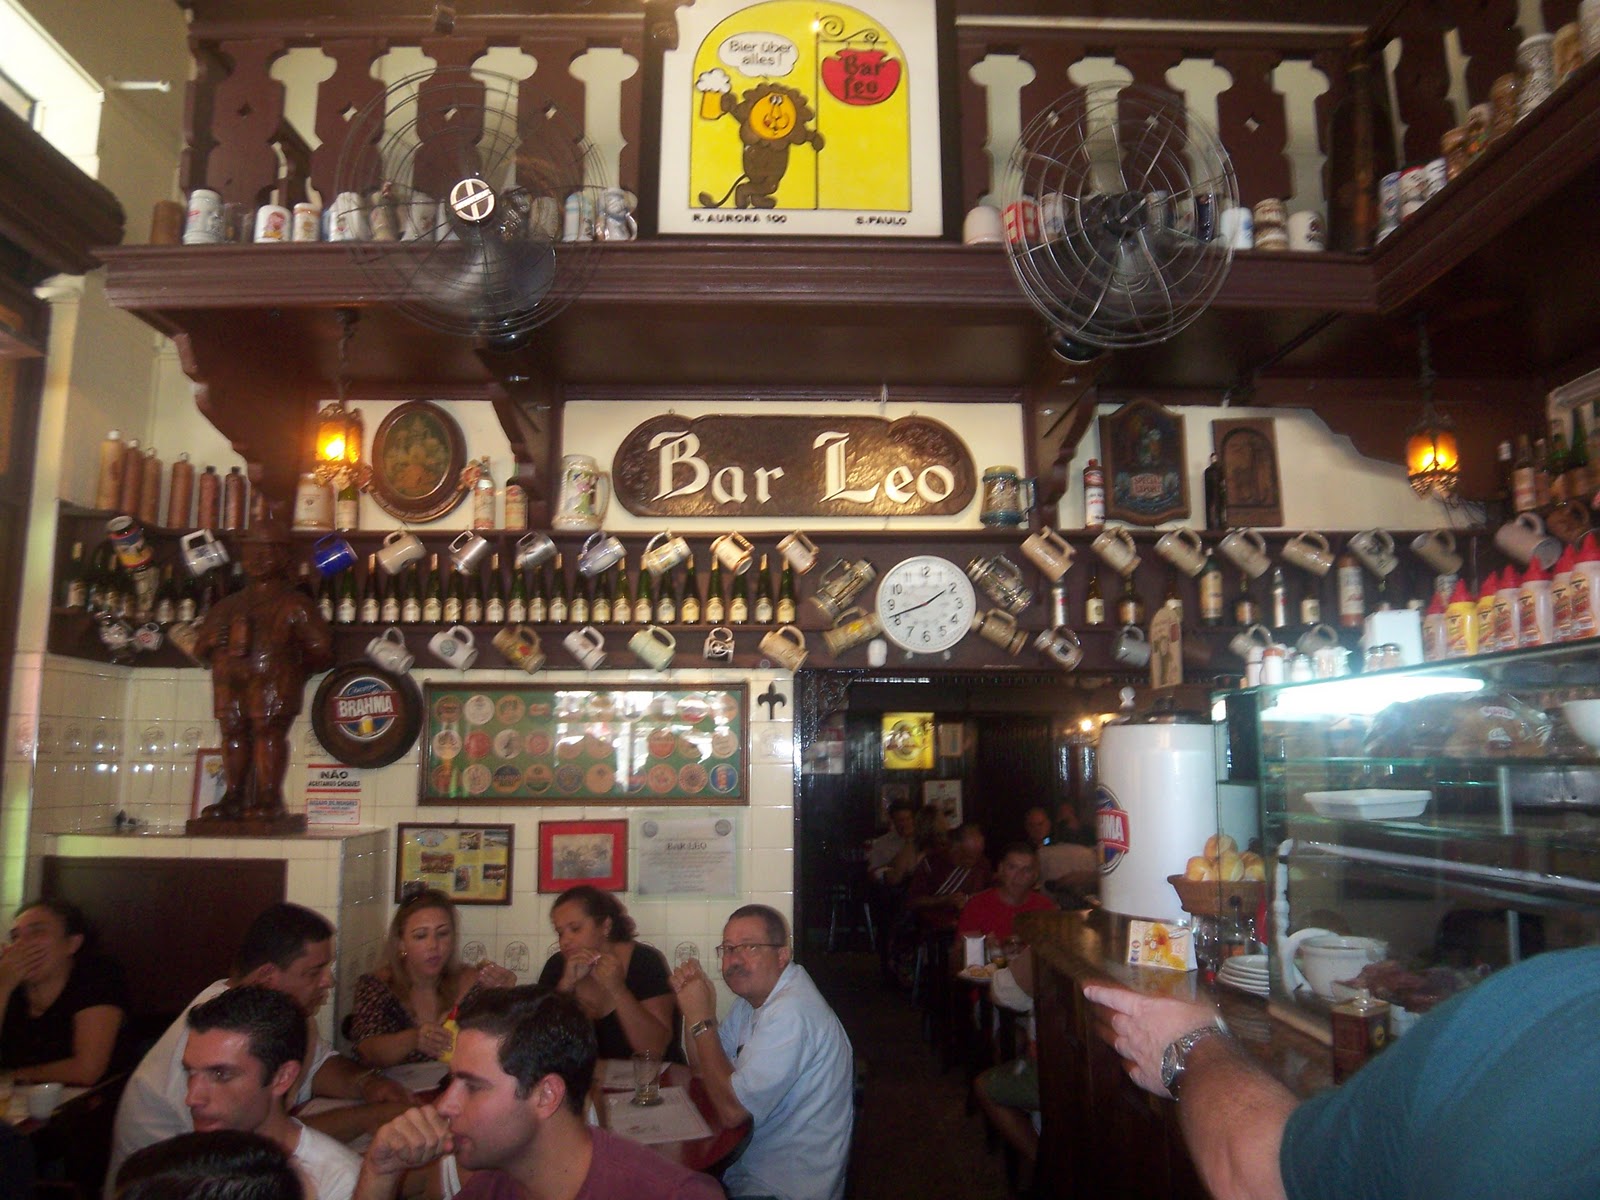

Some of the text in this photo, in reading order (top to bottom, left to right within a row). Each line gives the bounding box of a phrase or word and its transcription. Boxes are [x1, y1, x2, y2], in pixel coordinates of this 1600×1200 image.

[729, 40, 794, 53] Bier über
[844, 55, 886, 76] Bar
[707, 214, 761, 223] AURORA
[766, 214, 788, 223] 100
[647, 430, 956, 505] Bar Leo
[921, 566, 931, 577] 12
[892, 583, 903, 595] 10
[949, 582, 957, 594] 2
[887, 599, 896, 611] 9
[955, 597, 964, 609] 3
[951, 613, 959, 624] 4
[906, 626, 915, 638] 7
[922, 630, 931, 642] 6
[939, 625, 947, 637] 5
[339, 695, 394, 718] BRAHMA
[320, 769, 349, 779] NÃO
